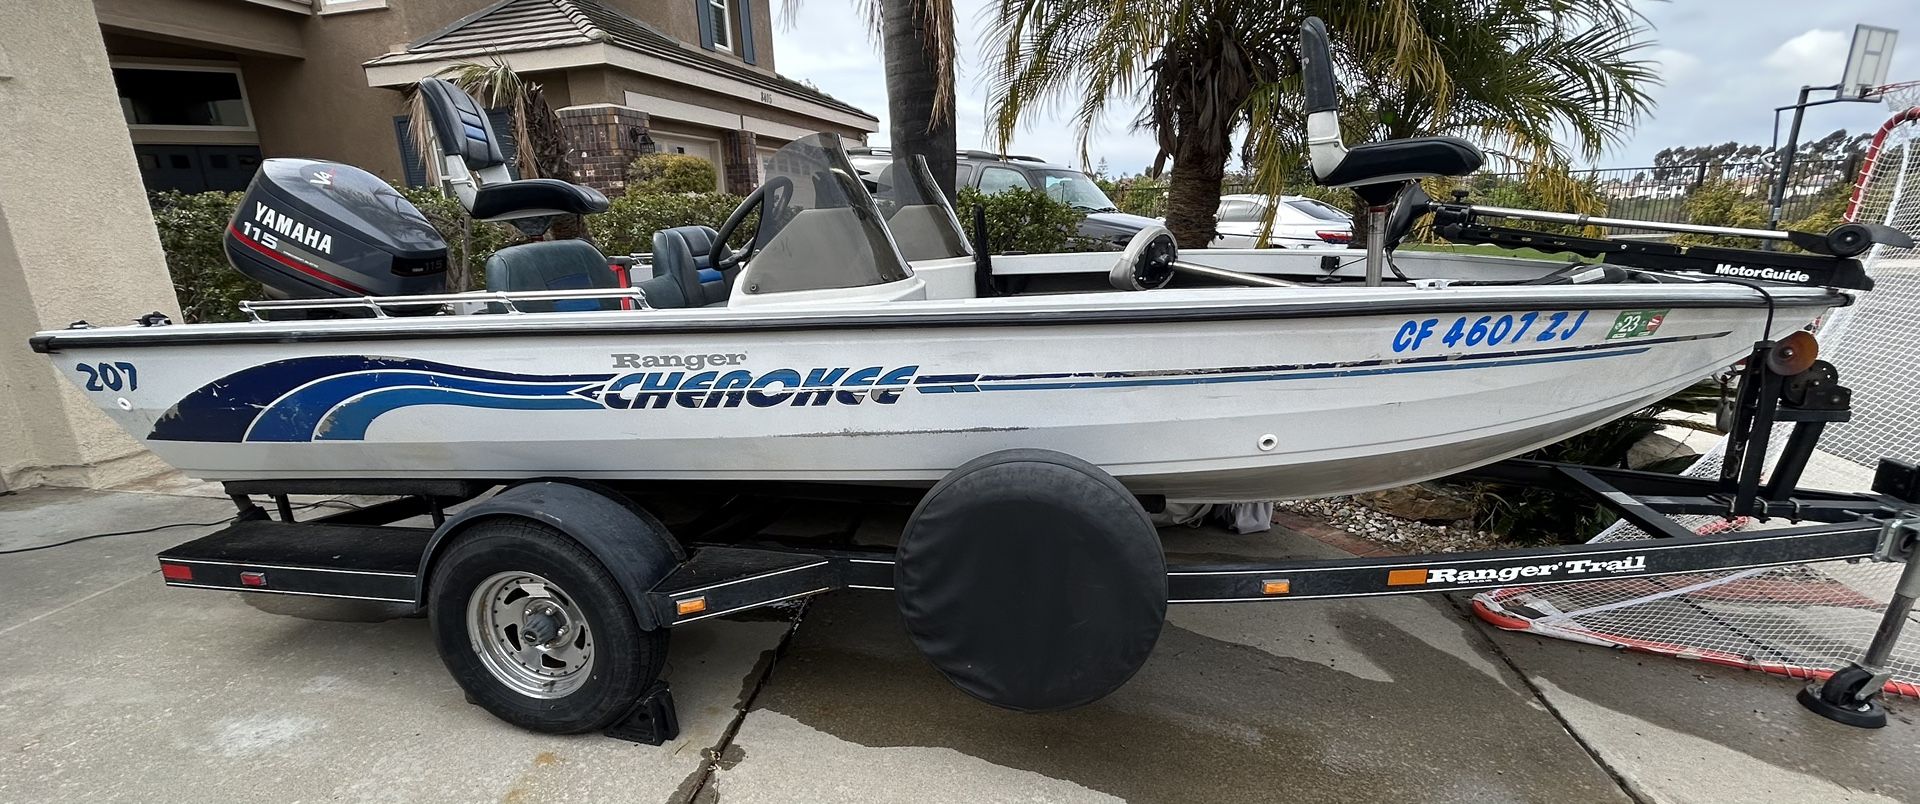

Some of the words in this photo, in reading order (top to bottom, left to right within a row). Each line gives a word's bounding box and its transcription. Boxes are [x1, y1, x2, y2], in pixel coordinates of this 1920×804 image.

[310, 171, 333, 186] V4
[243, 221, 279, 250] 115
[254, 200, 333, 254] YAMAHA
[425, 259, 443, 272] 115
[1715, 263, 1810, 282] MotorGuide
[1392, 318, 1439, 352] CF
[1442, 311, 1539, 349] 4607
[1536, 310, 1590, 342] ZJ
[1617, 315, 1642, 333] 23
[610, 352, 746, 371] Ranger
[76, 362, 138, 391] 207
[604, 365, 919, 410] CHEROKEE
[1427, 562, 1559, 582] Ranger
[1565, 555, 1646, 574] Trail
